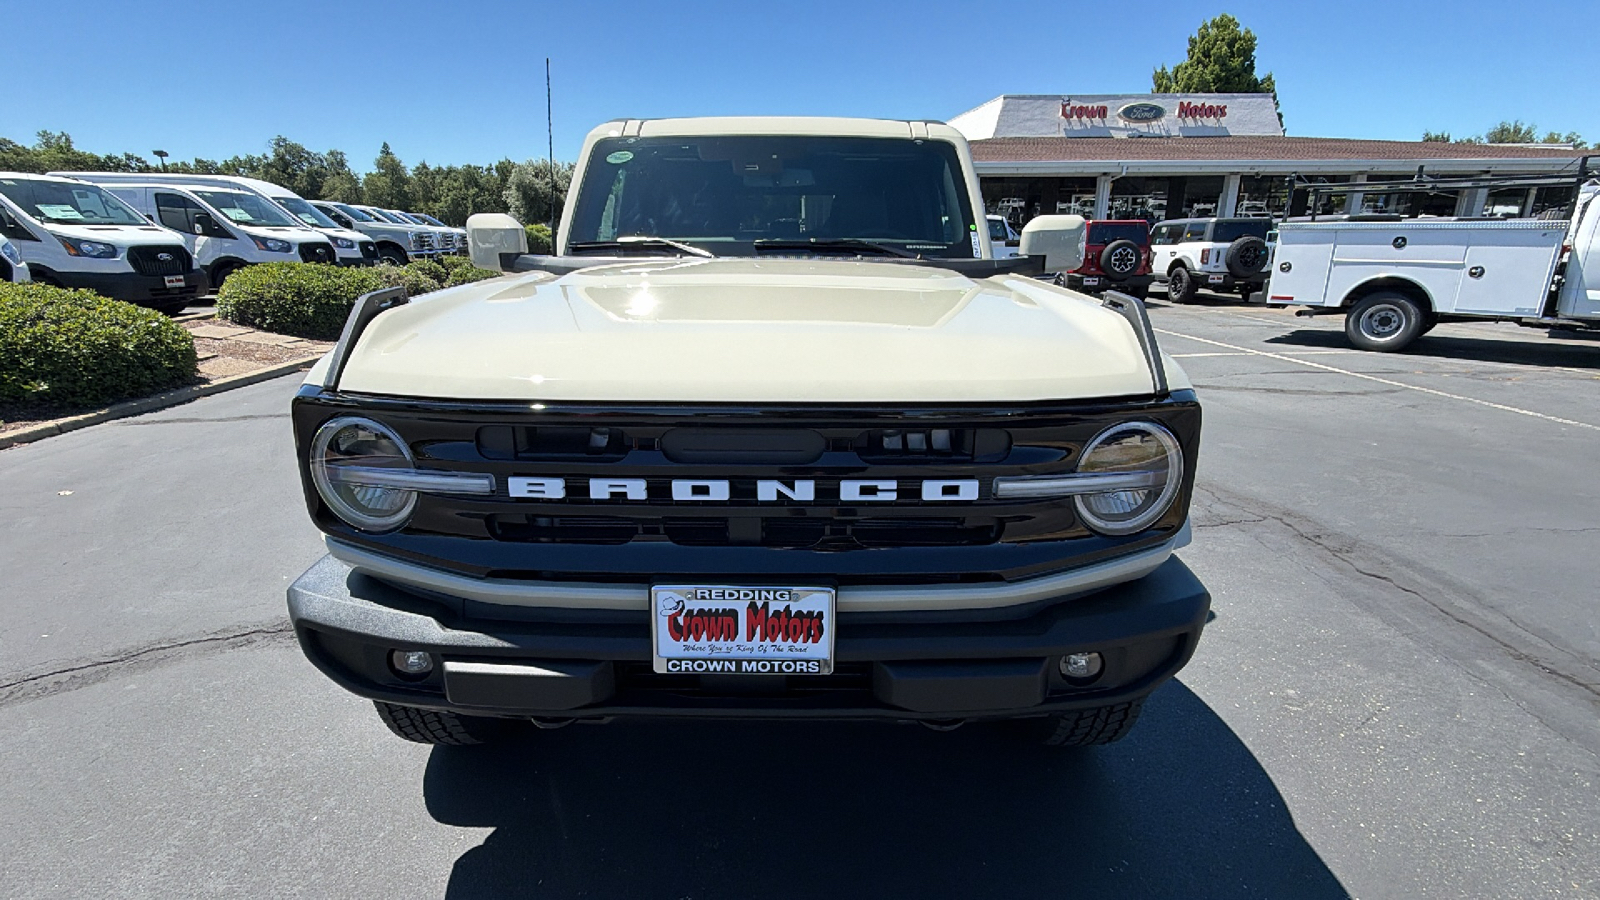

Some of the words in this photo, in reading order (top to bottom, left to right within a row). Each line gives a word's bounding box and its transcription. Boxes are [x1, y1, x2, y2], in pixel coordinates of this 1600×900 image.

[1061, 102, 1108, 119] Crown
[1130, 107, 1155, 119] Ford
[1177, 101, 1228, 118] Motors
[507, 476, 980, 501] BRONCO
[696, 589, 790, 601] REDDING
[667, 602, 739, 642] Crown
[746, 601, 824, 643] Motors
[682, 644, 706, 652] Where
[708, 644, 734, 655] You're
[736, 644, 755, 653] King
[757, 644, 768, 654] Of
[771, 644, 785, 653] The
[787, 645, 809, 653] Road
[667, 659, 736, 672] CROWN
[742, 660, 819, 673] MOTORS
